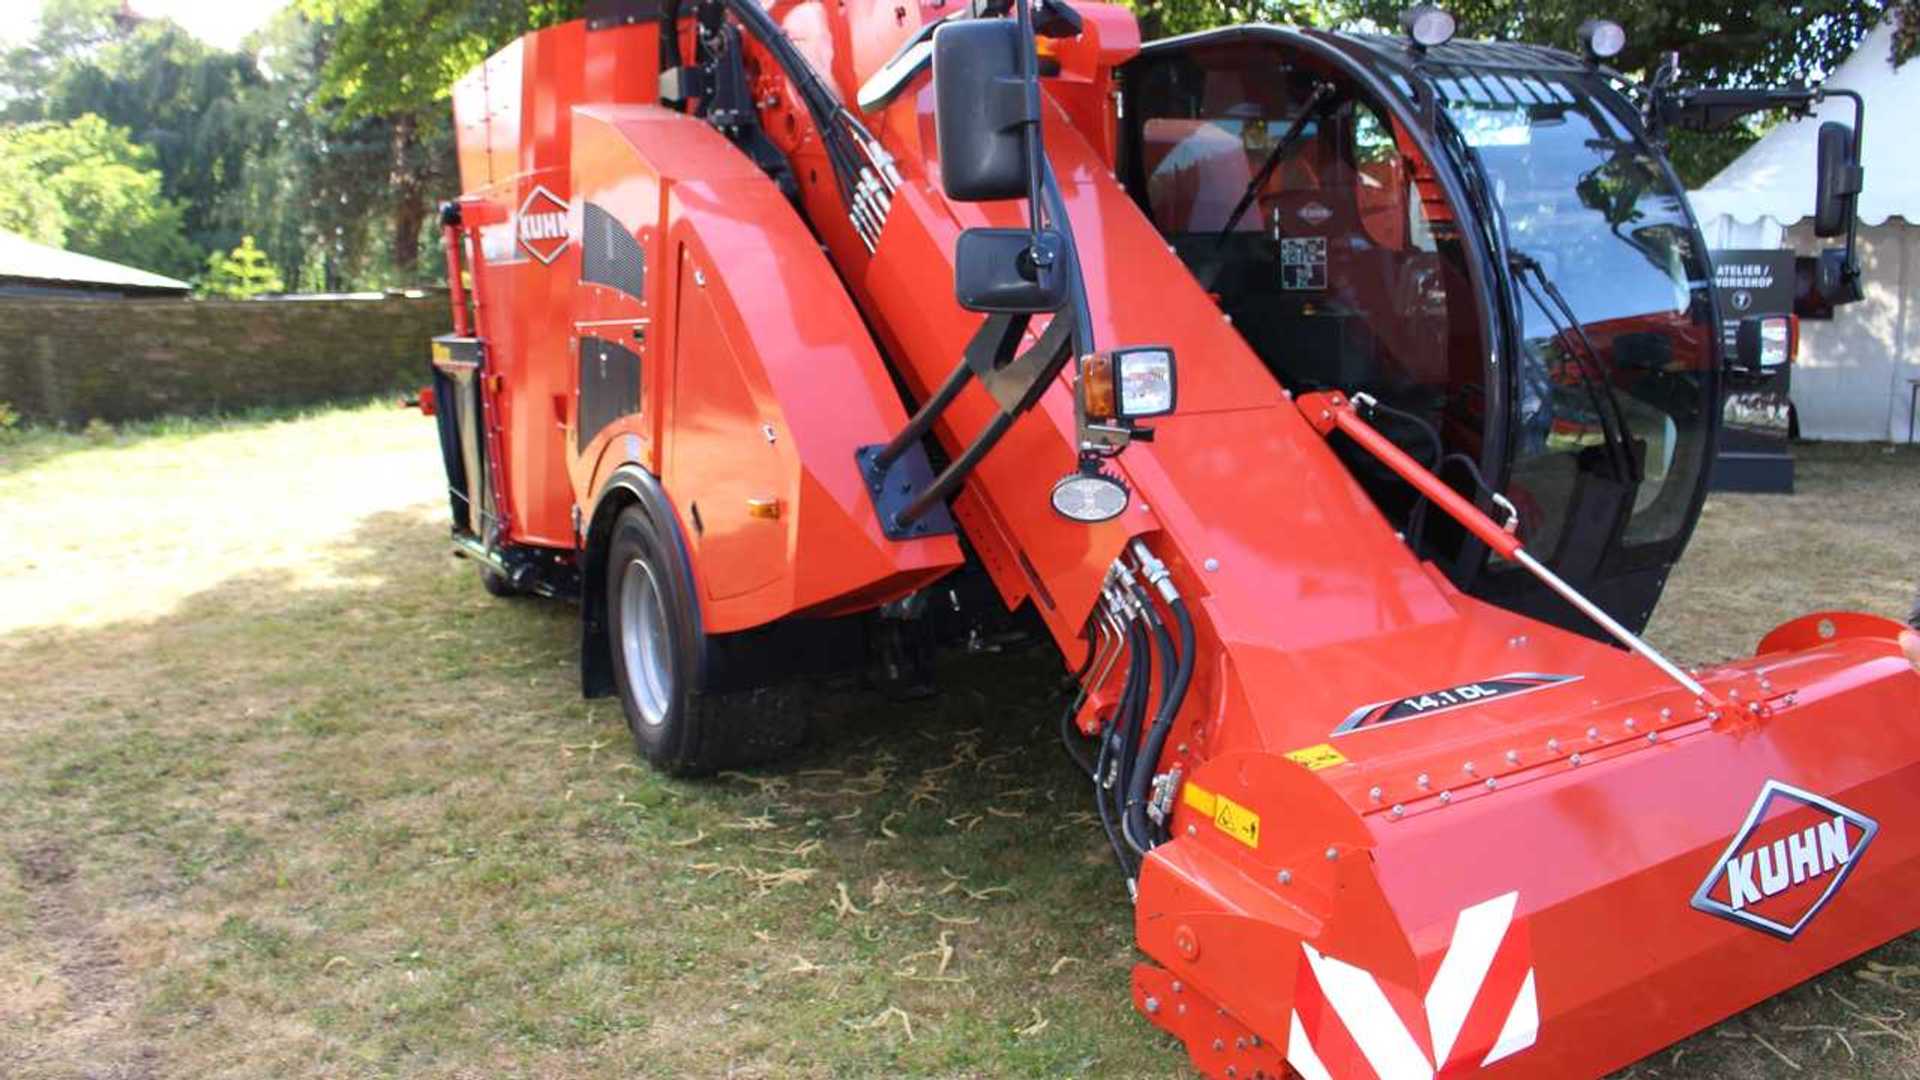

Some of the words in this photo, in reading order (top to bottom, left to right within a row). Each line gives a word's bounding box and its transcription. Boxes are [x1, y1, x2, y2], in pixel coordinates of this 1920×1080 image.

[1716, 264, 1761, 276] ATELIER
[1404, 691, 1458, 711] 14.1
[1455, 684, 1498, 700] DL
[1727, 816, 1850, 911] KUHN
